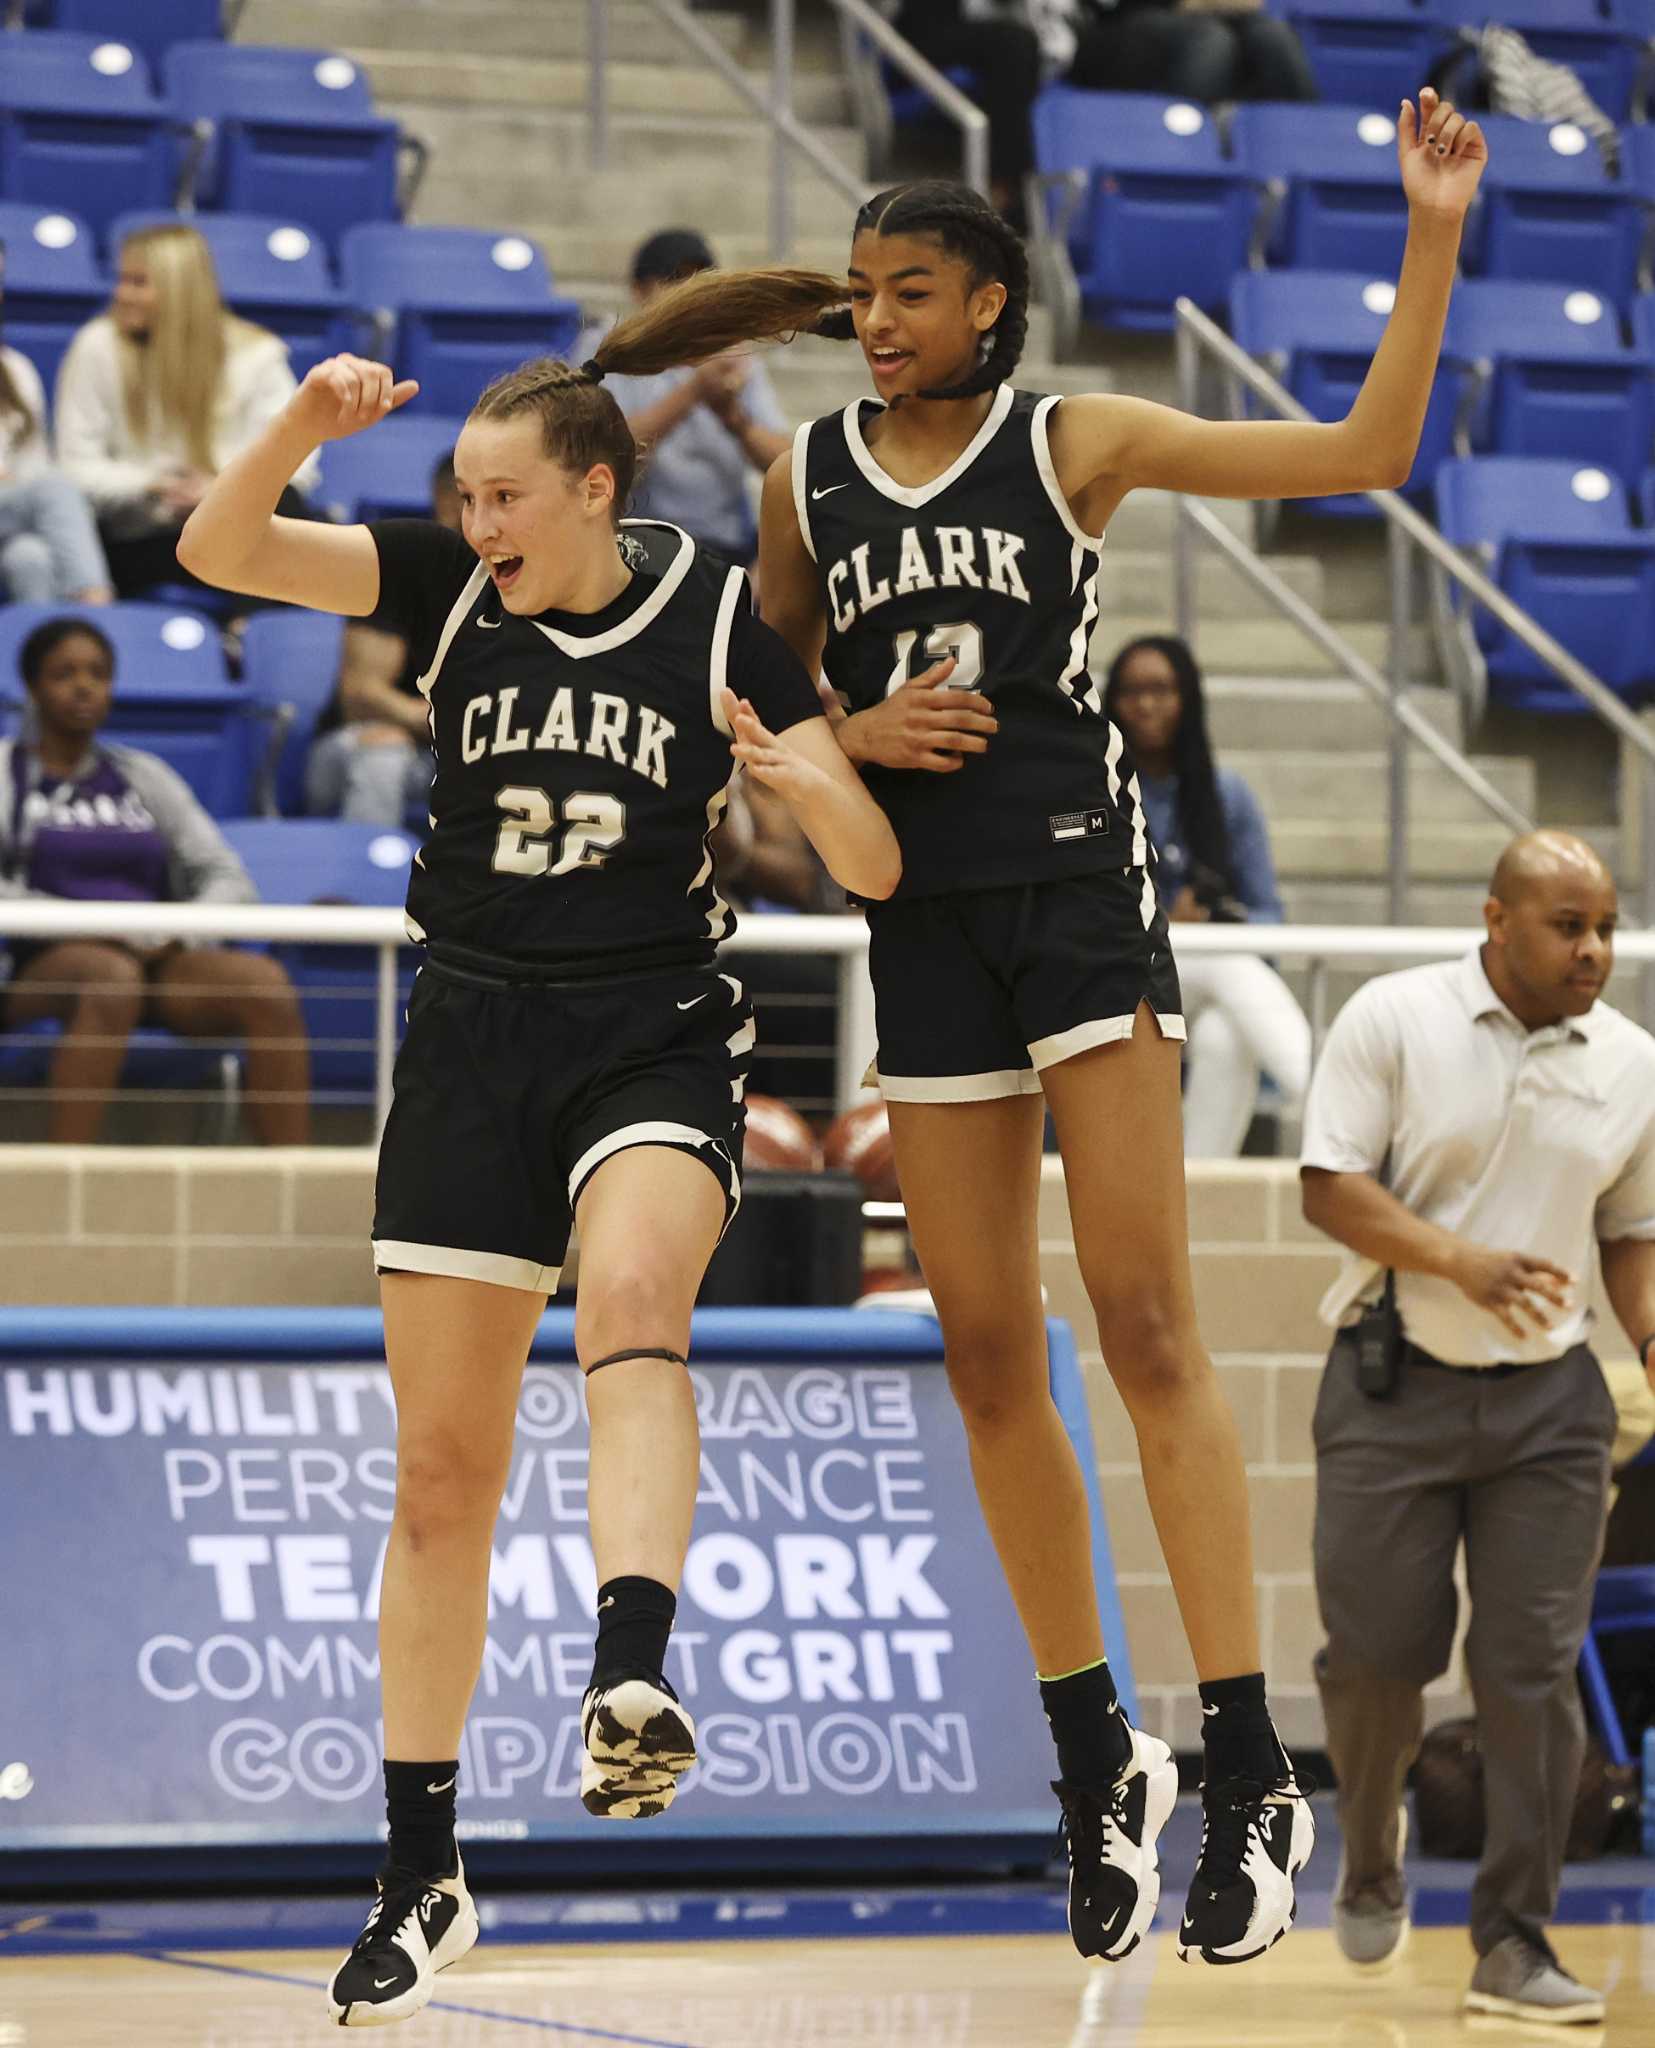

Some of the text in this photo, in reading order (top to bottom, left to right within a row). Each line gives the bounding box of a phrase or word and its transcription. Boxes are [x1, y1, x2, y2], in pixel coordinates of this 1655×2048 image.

[826, 524, 1032, 634] CLARK
[460, 685, 677, 790] CLARK
[491, 784, 627, 877] 22
[1091, 816, 1103, 829] M
[163, 1447, 934, 1523] PERSVEANCE
[188, 1532, 950, 1623] TEMORK
[137, 1629, 953, 1703] COMMMET GRIT
[208, 1711, 978, 1802] COPSION
